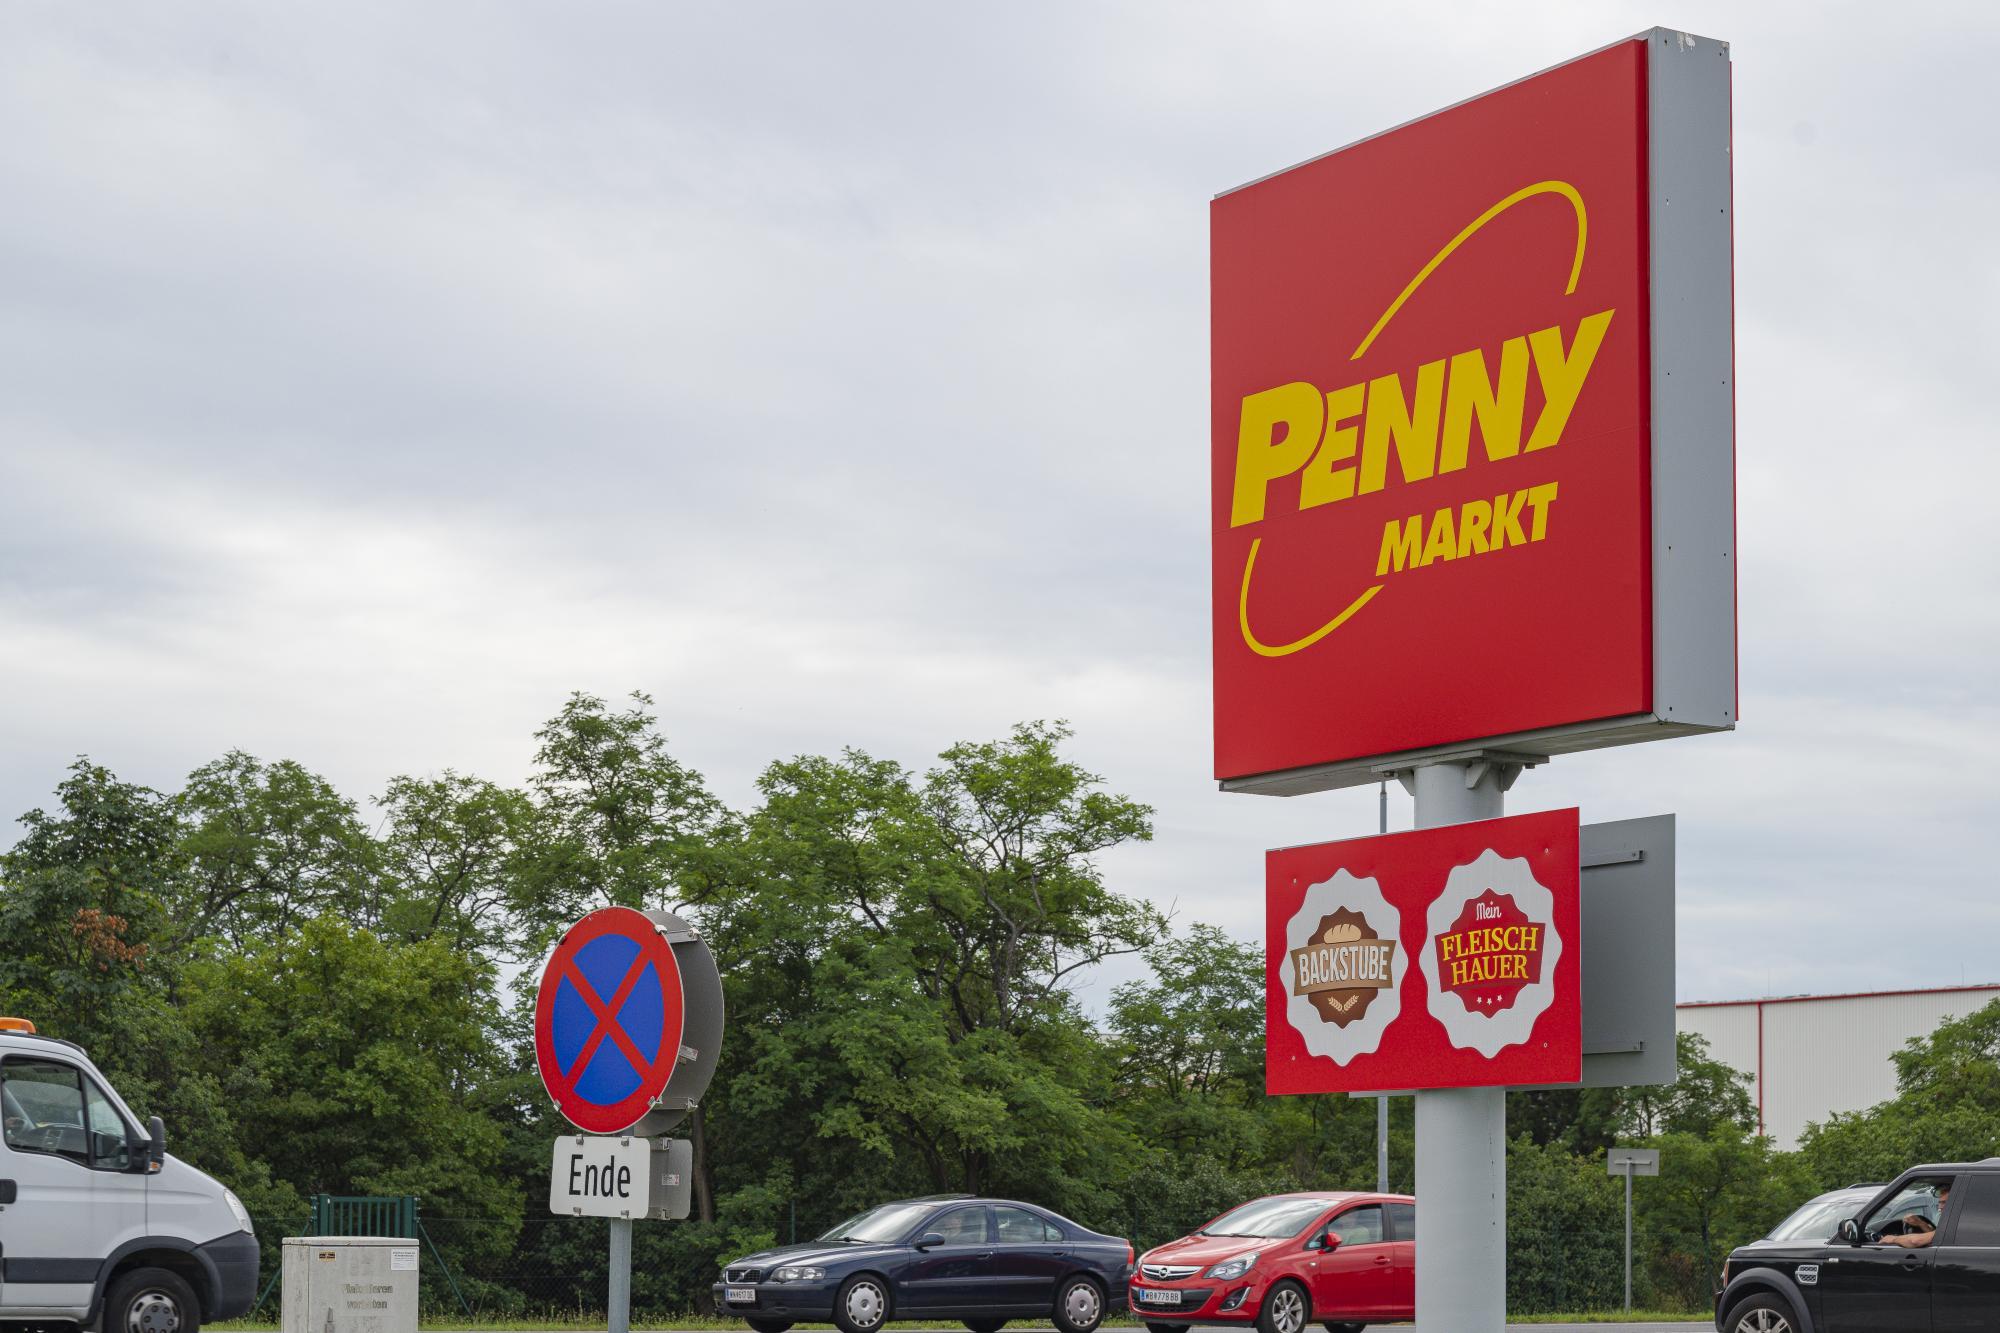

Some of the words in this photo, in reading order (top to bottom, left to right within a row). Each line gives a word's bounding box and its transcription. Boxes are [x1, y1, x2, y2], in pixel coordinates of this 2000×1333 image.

[1230, 308, 1616, 528] PENNY
[1375, 481, 1559, 577] MARKT
[1476, 901, 1502, 921] Mein
[1441, 927, 1538, 961] FLEISCH
[1299, 945, 1390, 987] BACKSTUBE
[1451, 955, 1529, 986] HAUER
[568, 1153, 631, 1198] Ende
